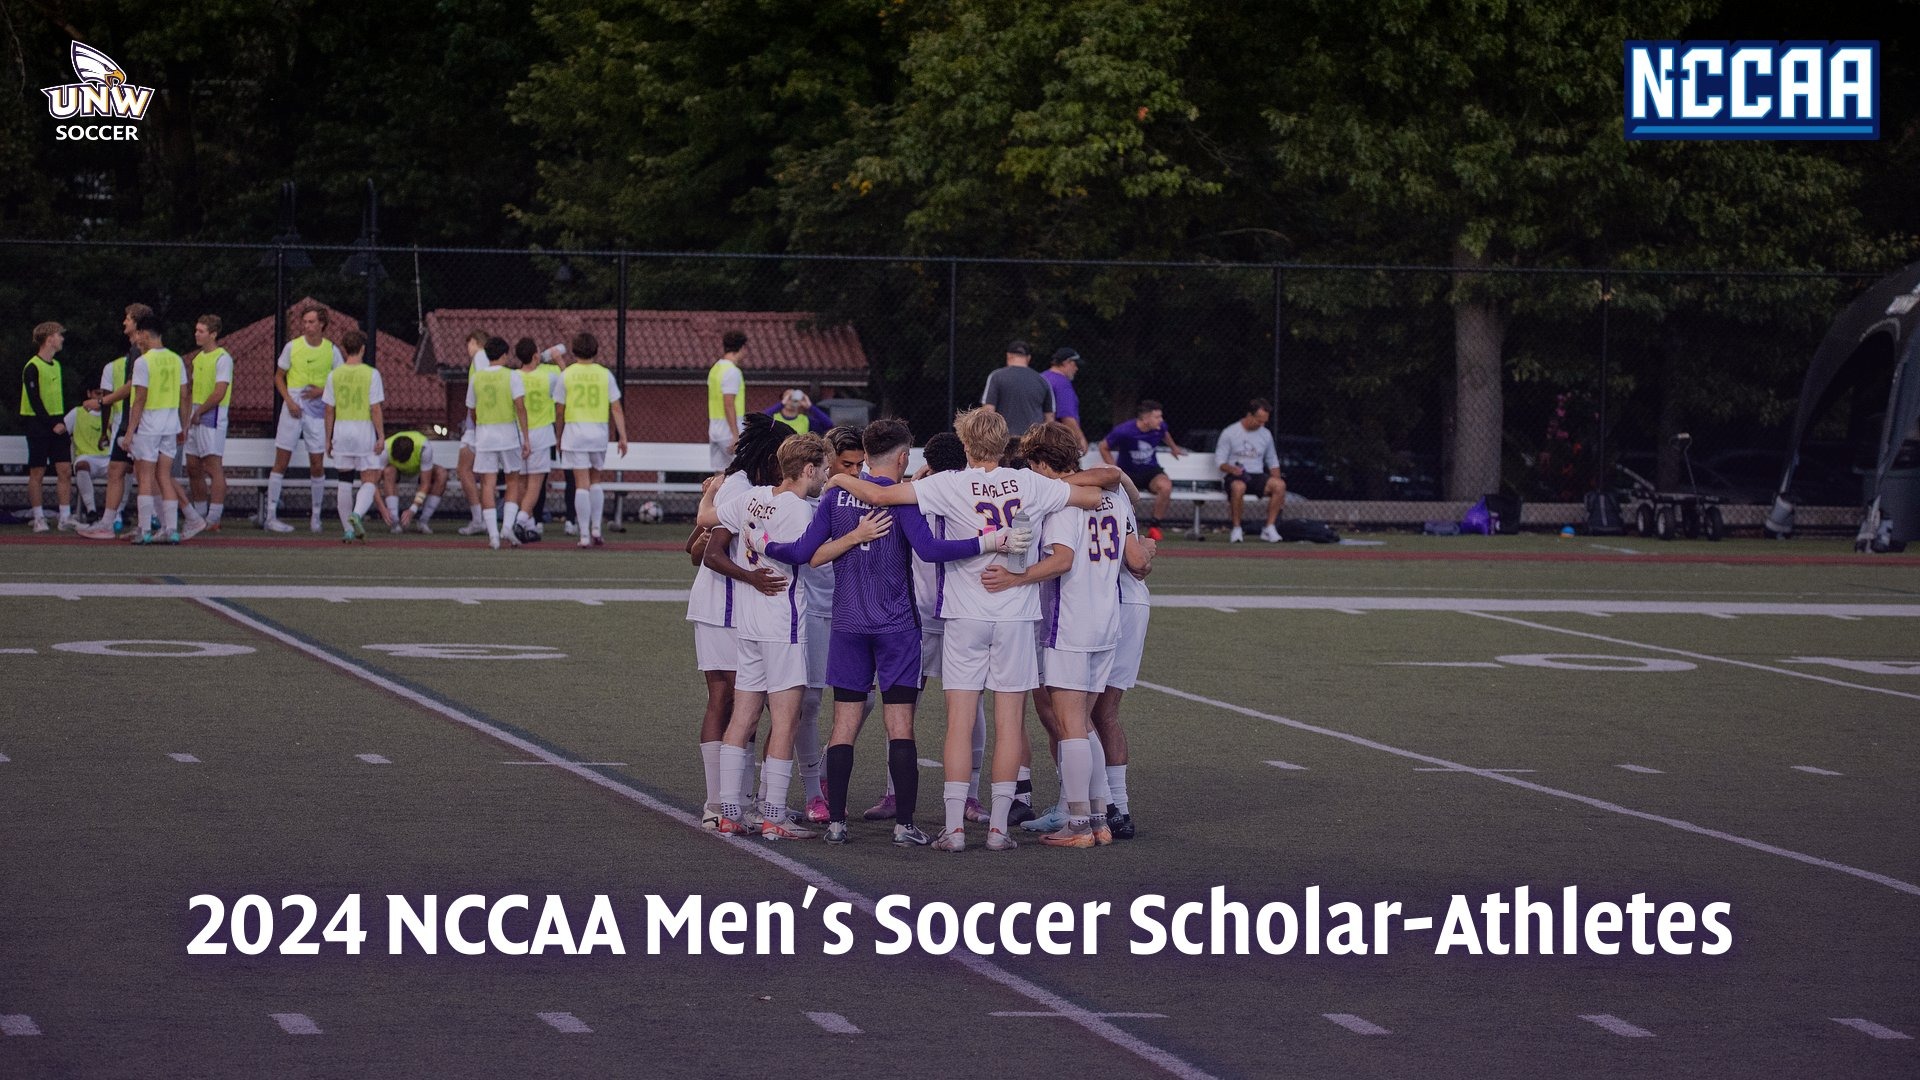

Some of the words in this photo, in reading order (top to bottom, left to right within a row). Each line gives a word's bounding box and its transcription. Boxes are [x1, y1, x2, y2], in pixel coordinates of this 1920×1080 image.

[160, 367, 176, 393] 21
[338, 385, 363, 410] 34
[483, 384, 497, 409] 3
[528, 390, 543, 413] 6
[573, 383, 600, 408] 28
[971, 479, 1019, 498] EAGLES
[1088, 515, 1120, 561] 33
